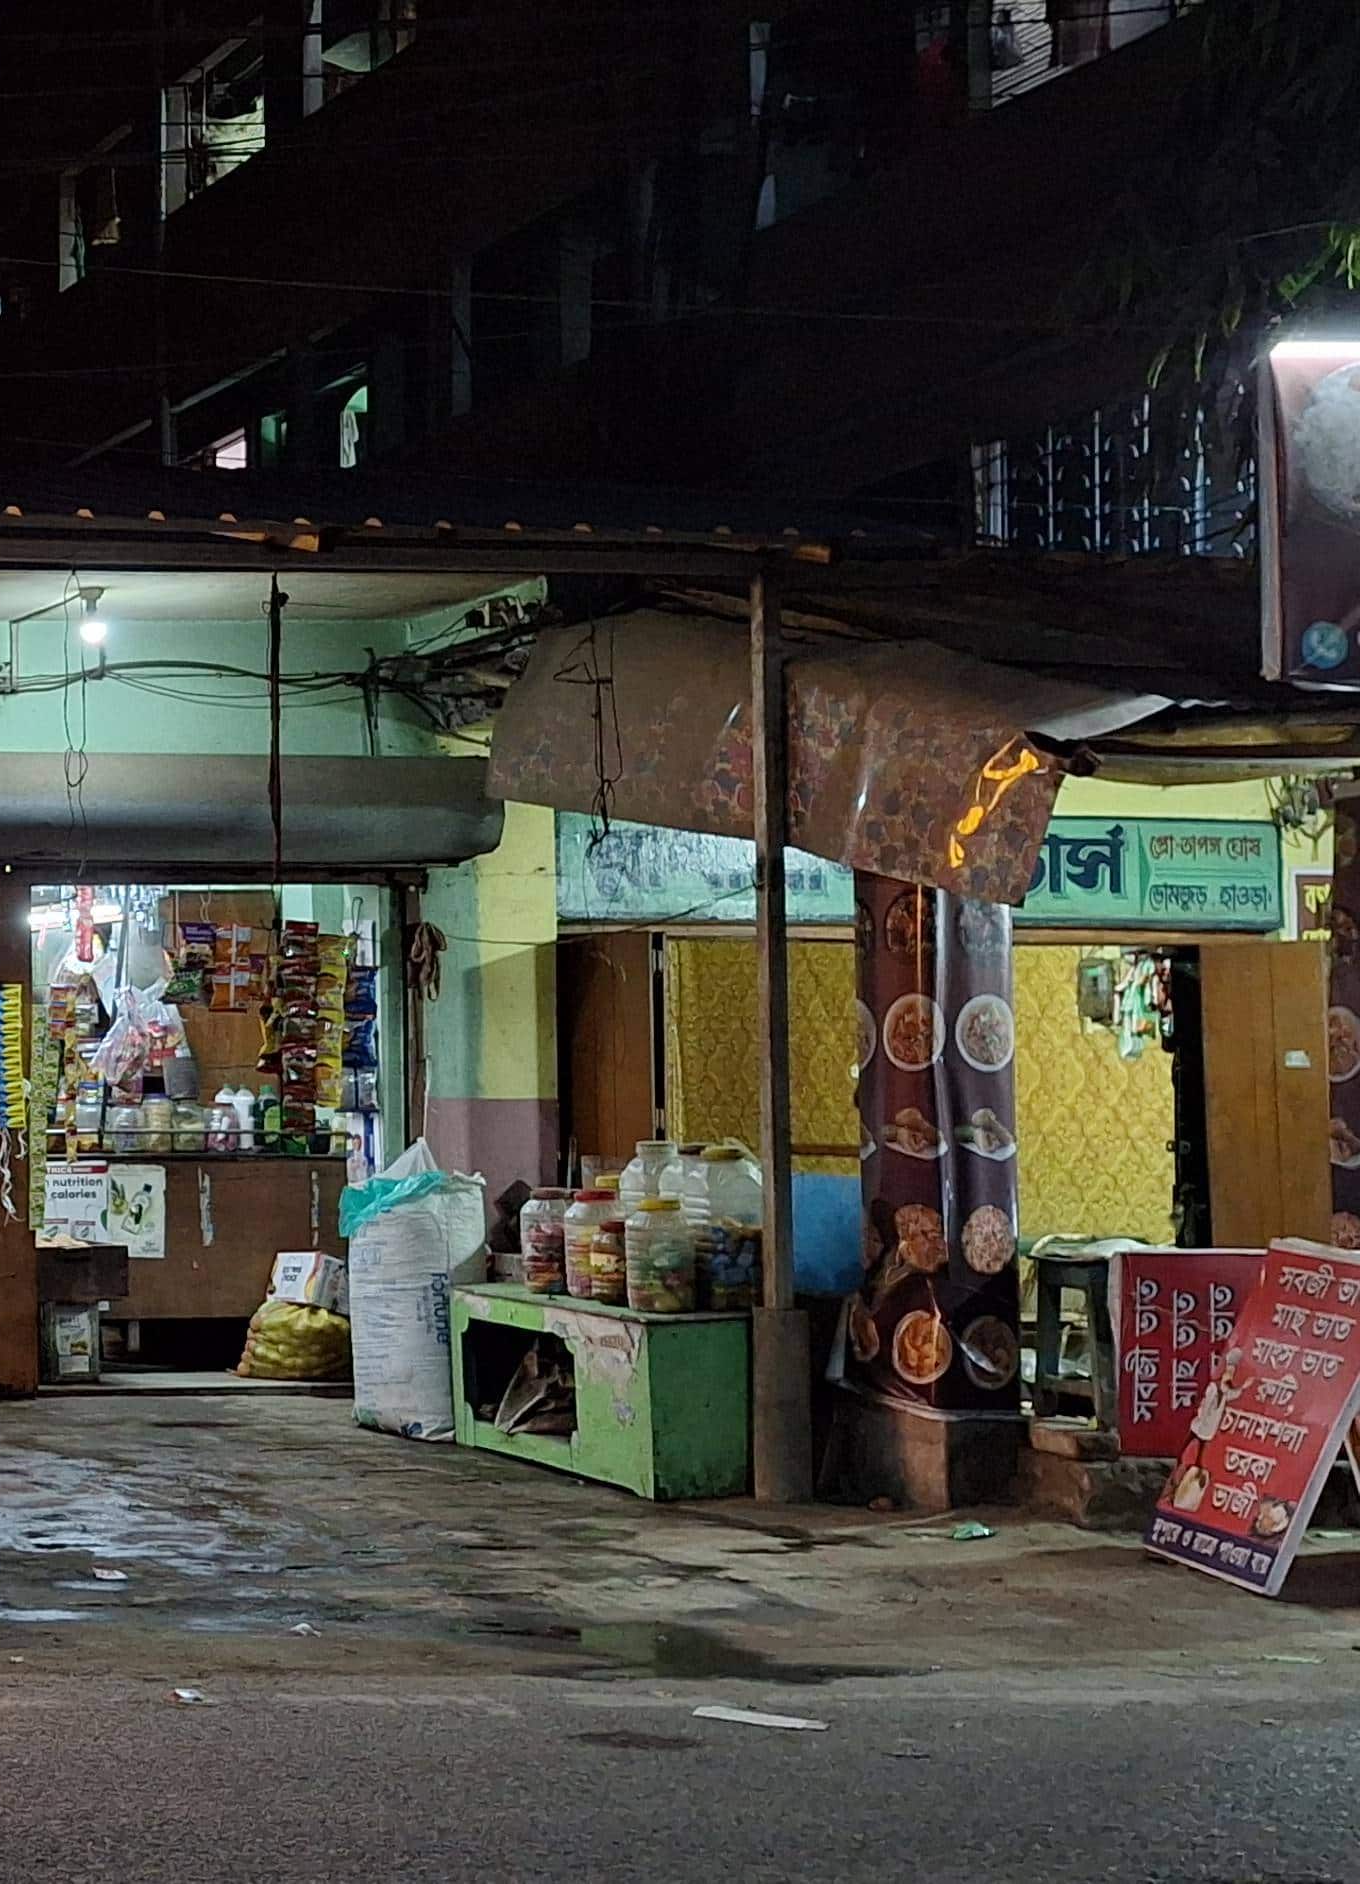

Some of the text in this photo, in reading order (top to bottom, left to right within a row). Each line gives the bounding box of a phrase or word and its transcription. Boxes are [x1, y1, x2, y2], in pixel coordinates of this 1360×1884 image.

[50, 1188, 97, 1200] calories
[52, 1175, 104, 1188] nutrition
[431, 1272, 451, 1346] fortune
[1135, 1276, 1159, 1338] ভাত
[1338, 1277, 1360, 1306] ভা
[1172, 1289, 1197, 1353] ভাত
[1210, 1282, 1235, 1344] ভাত
[1272, 1303, 1358, 1341] মাছ ভাত
[1301, 1348, 1345, 1380] ভাত
[1225, 1445, 1278, 1485] তরকা
